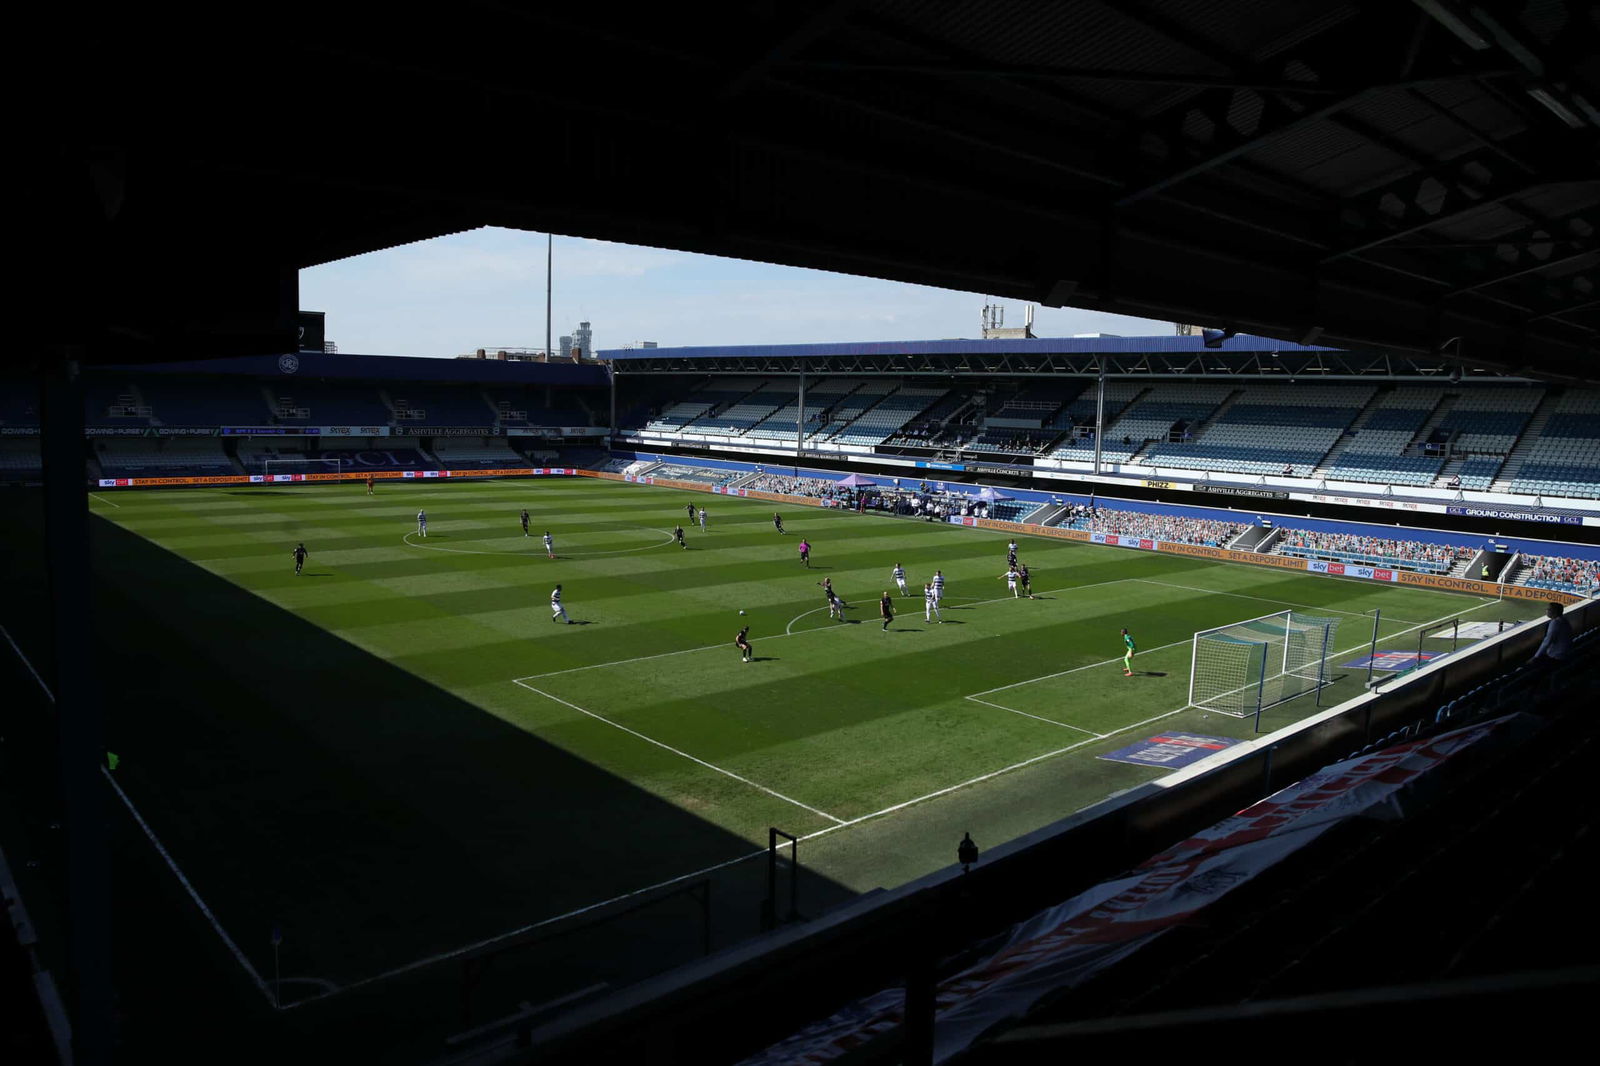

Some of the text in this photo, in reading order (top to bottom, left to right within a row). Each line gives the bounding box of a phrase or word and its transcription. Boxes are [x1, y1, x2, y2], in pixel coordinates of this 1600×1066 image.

[1147, 481, 1169, 489] PHIZZ
[1207, 487, 1273, 498] ASHVILLE AGGREGATES
[1465, 508, 1499, 518] GROUND
[1499, 512, 1561, 523] CONSTRUCTION
[1160, 543, 1176, 551] STAY
[1229, 551, 1241, 560] SET
[1250, 554, 1281, 565] DEPOSIT
[1283, 559, 1304, 568] LIMIT
[1313, 561, 1344, 573] sky bet
[1358, 567, 1391, 579] sky bet
[1401, 573, 1423, 584] STAY
[1425, 576, 1435, 585] IN
[1496, 585, 1514, 596] SET
[1525, 590, 1563, 602] DEPOSIT
